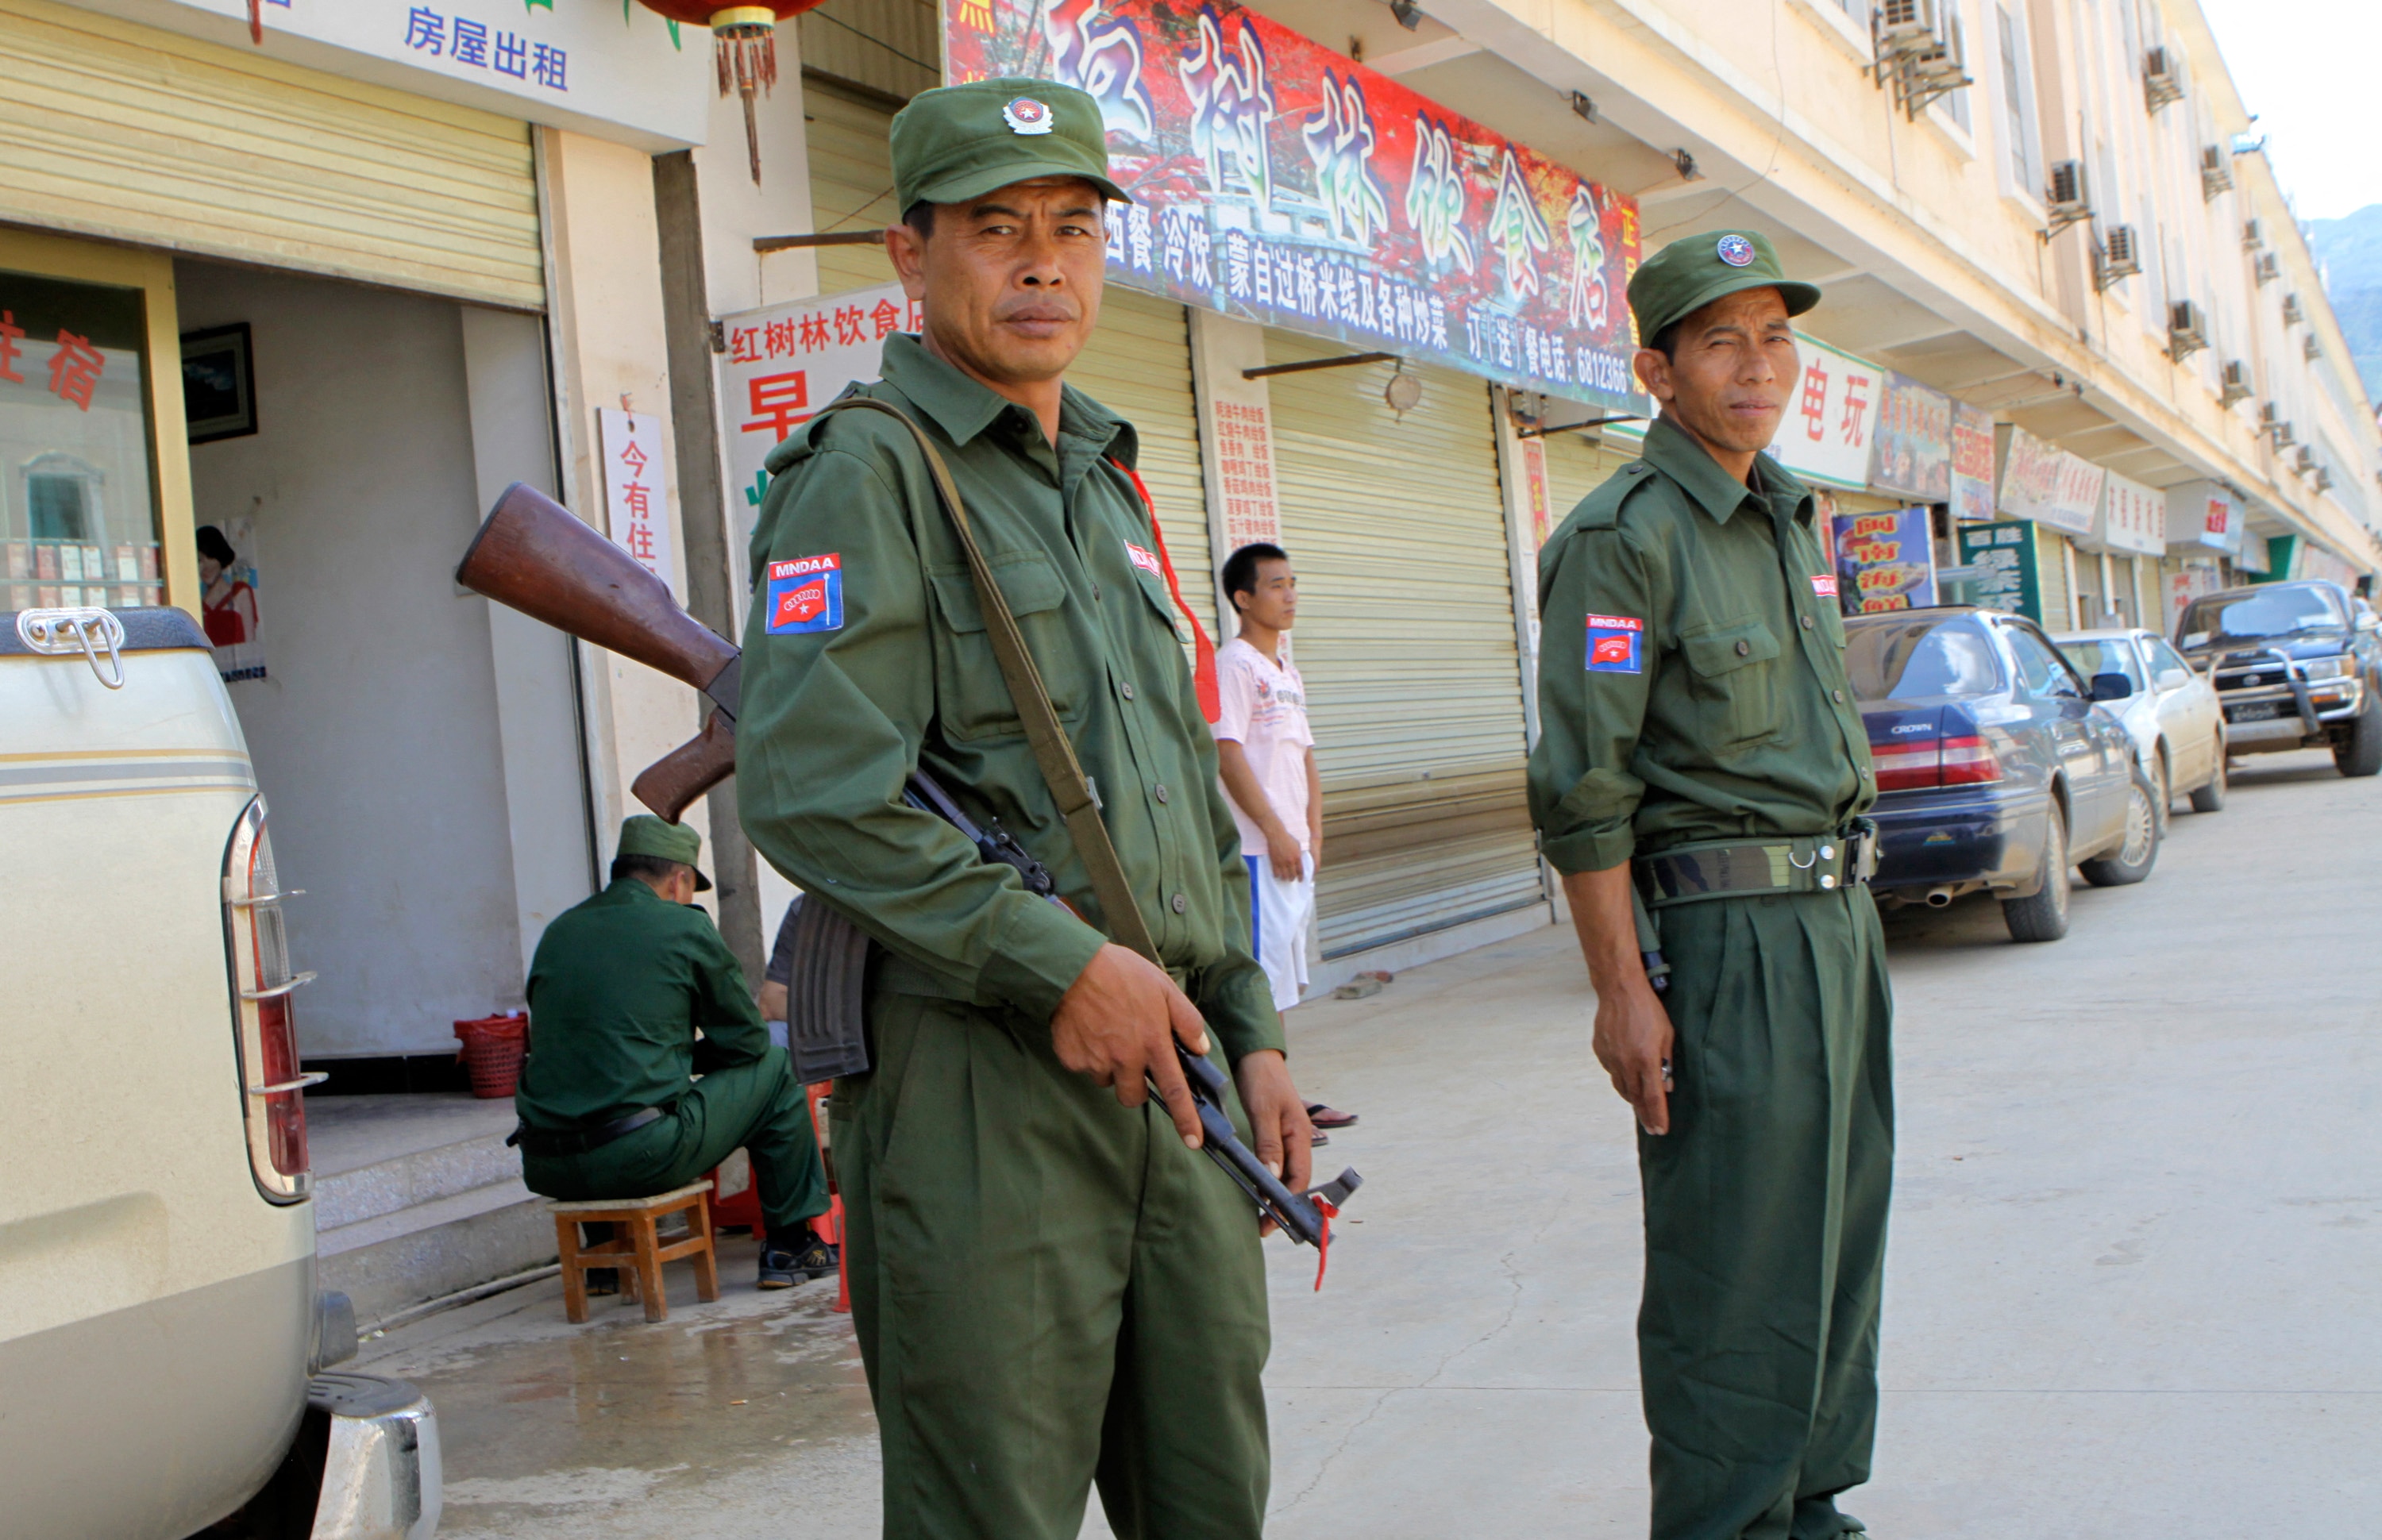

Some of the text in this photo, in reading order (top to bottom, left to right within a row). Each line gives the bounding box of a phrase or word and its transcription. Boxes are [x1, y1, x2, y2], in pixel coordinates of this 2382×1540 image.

[404, 6, 569, 93] 房屋出租
[1162, 212, 1213, 288] 冷饮
[1228, 233, 1449, 350] 蒙自过桥米线及各种炒菜
[741, 369, 817, 445] 早
[1801, 358, 1869, 448] 电玩
[620, 440, 657, 572] 今有住
[775, 557, 834, 577] MNDAA
[1590, 618, 1637, 629] MNDAA
[1891, 723, 1933, 734] CROWN
